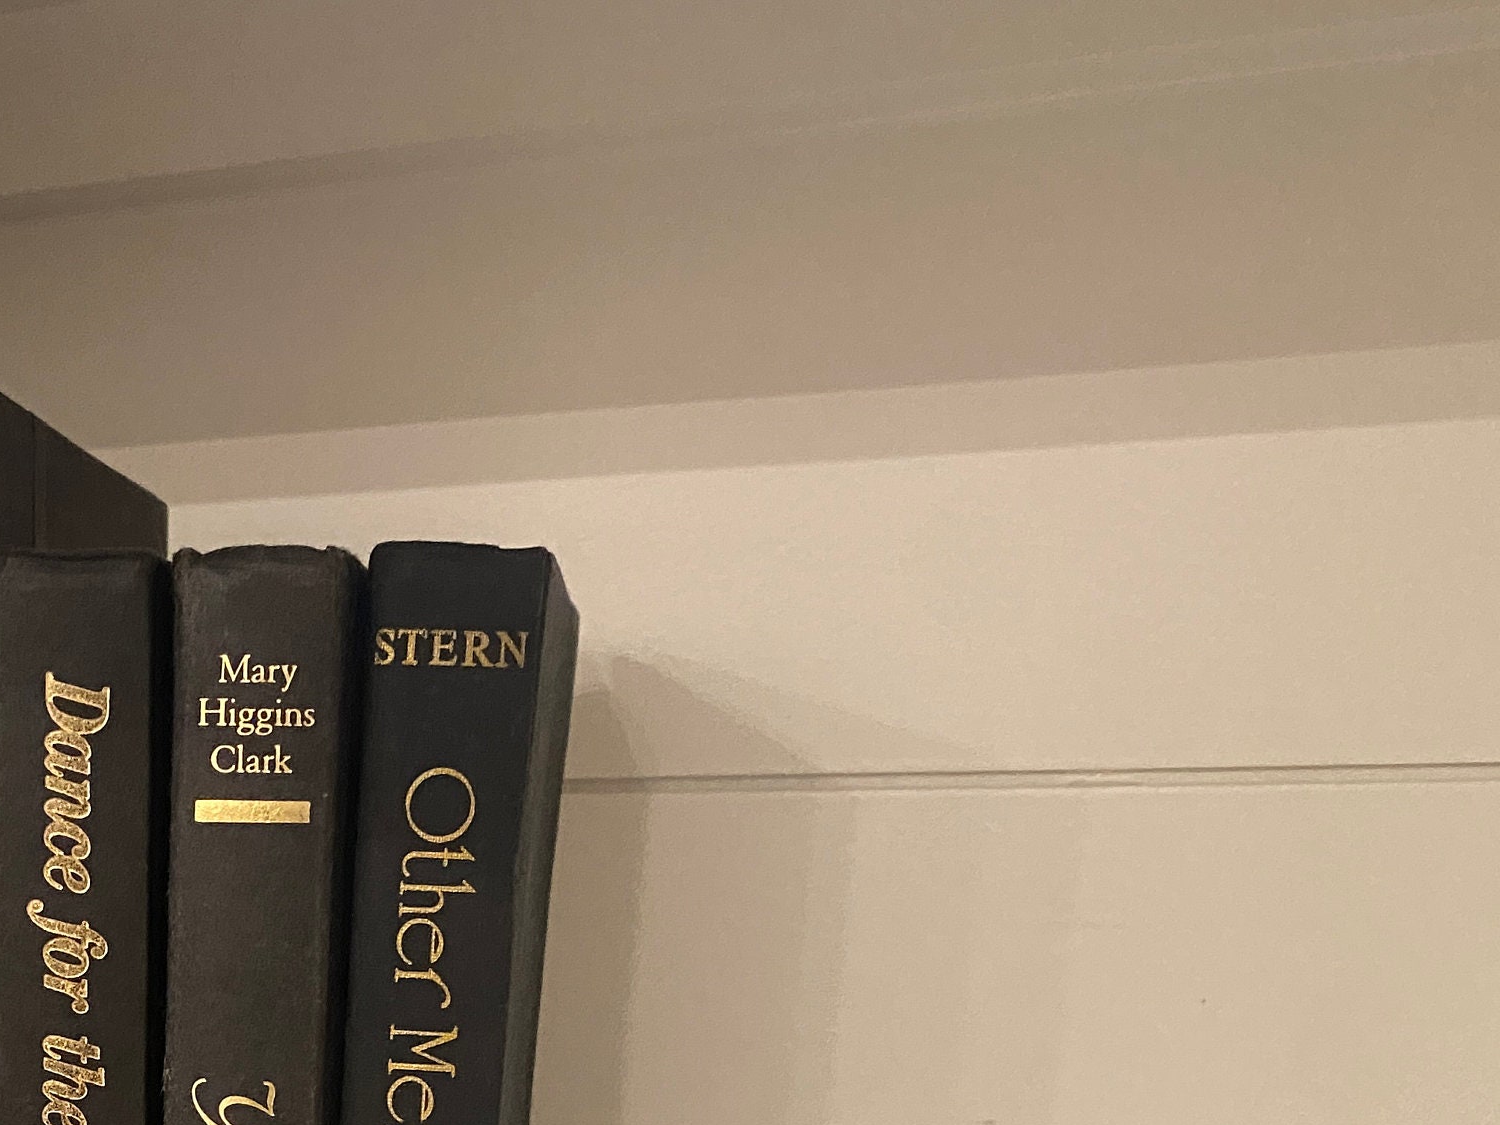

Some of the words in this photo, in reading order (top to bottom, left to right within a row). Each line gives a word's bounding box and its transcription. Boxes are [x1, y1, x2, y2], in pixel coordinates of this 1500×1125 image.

[375, 629, 528, 667] STERN
[218, 654, 298, 693] Mary
[198, 698, 315, 735] Higgins
[211, 744, 292, 773] Clark
[42, 671, 111, 894] Dance
[394, 768, 476, 1008] Other
[26, 899, 109, 1014] for
